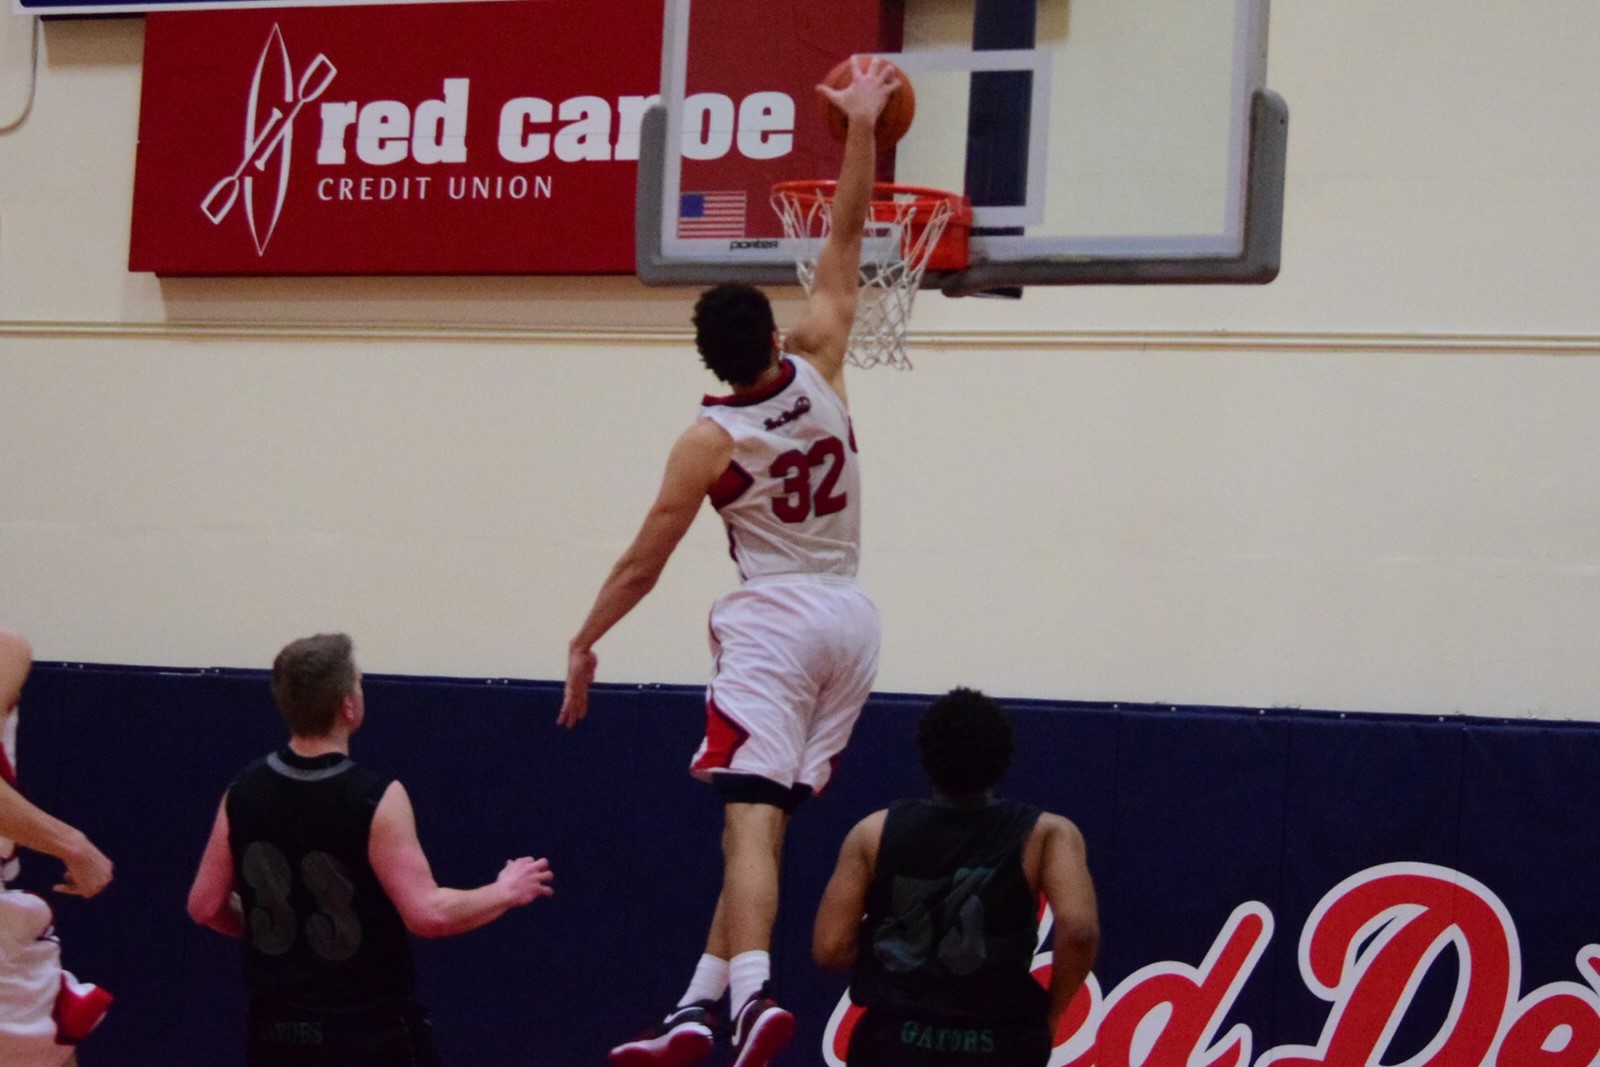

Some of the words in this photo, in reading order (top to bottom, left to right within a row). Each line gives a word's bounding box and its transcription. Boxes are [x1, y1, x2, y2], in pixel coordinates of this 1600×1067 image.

[317, 77, 470, 165] red
[317, 177, 432, 200] CREDIT
[449, 175, 552, 199] UNION
[769, 435, 848, 523] 32
[242, 840, 362, 961] 33
[1253, 861, 1600, 1067] De
[901, 1020, 994, 1053] GATORS
